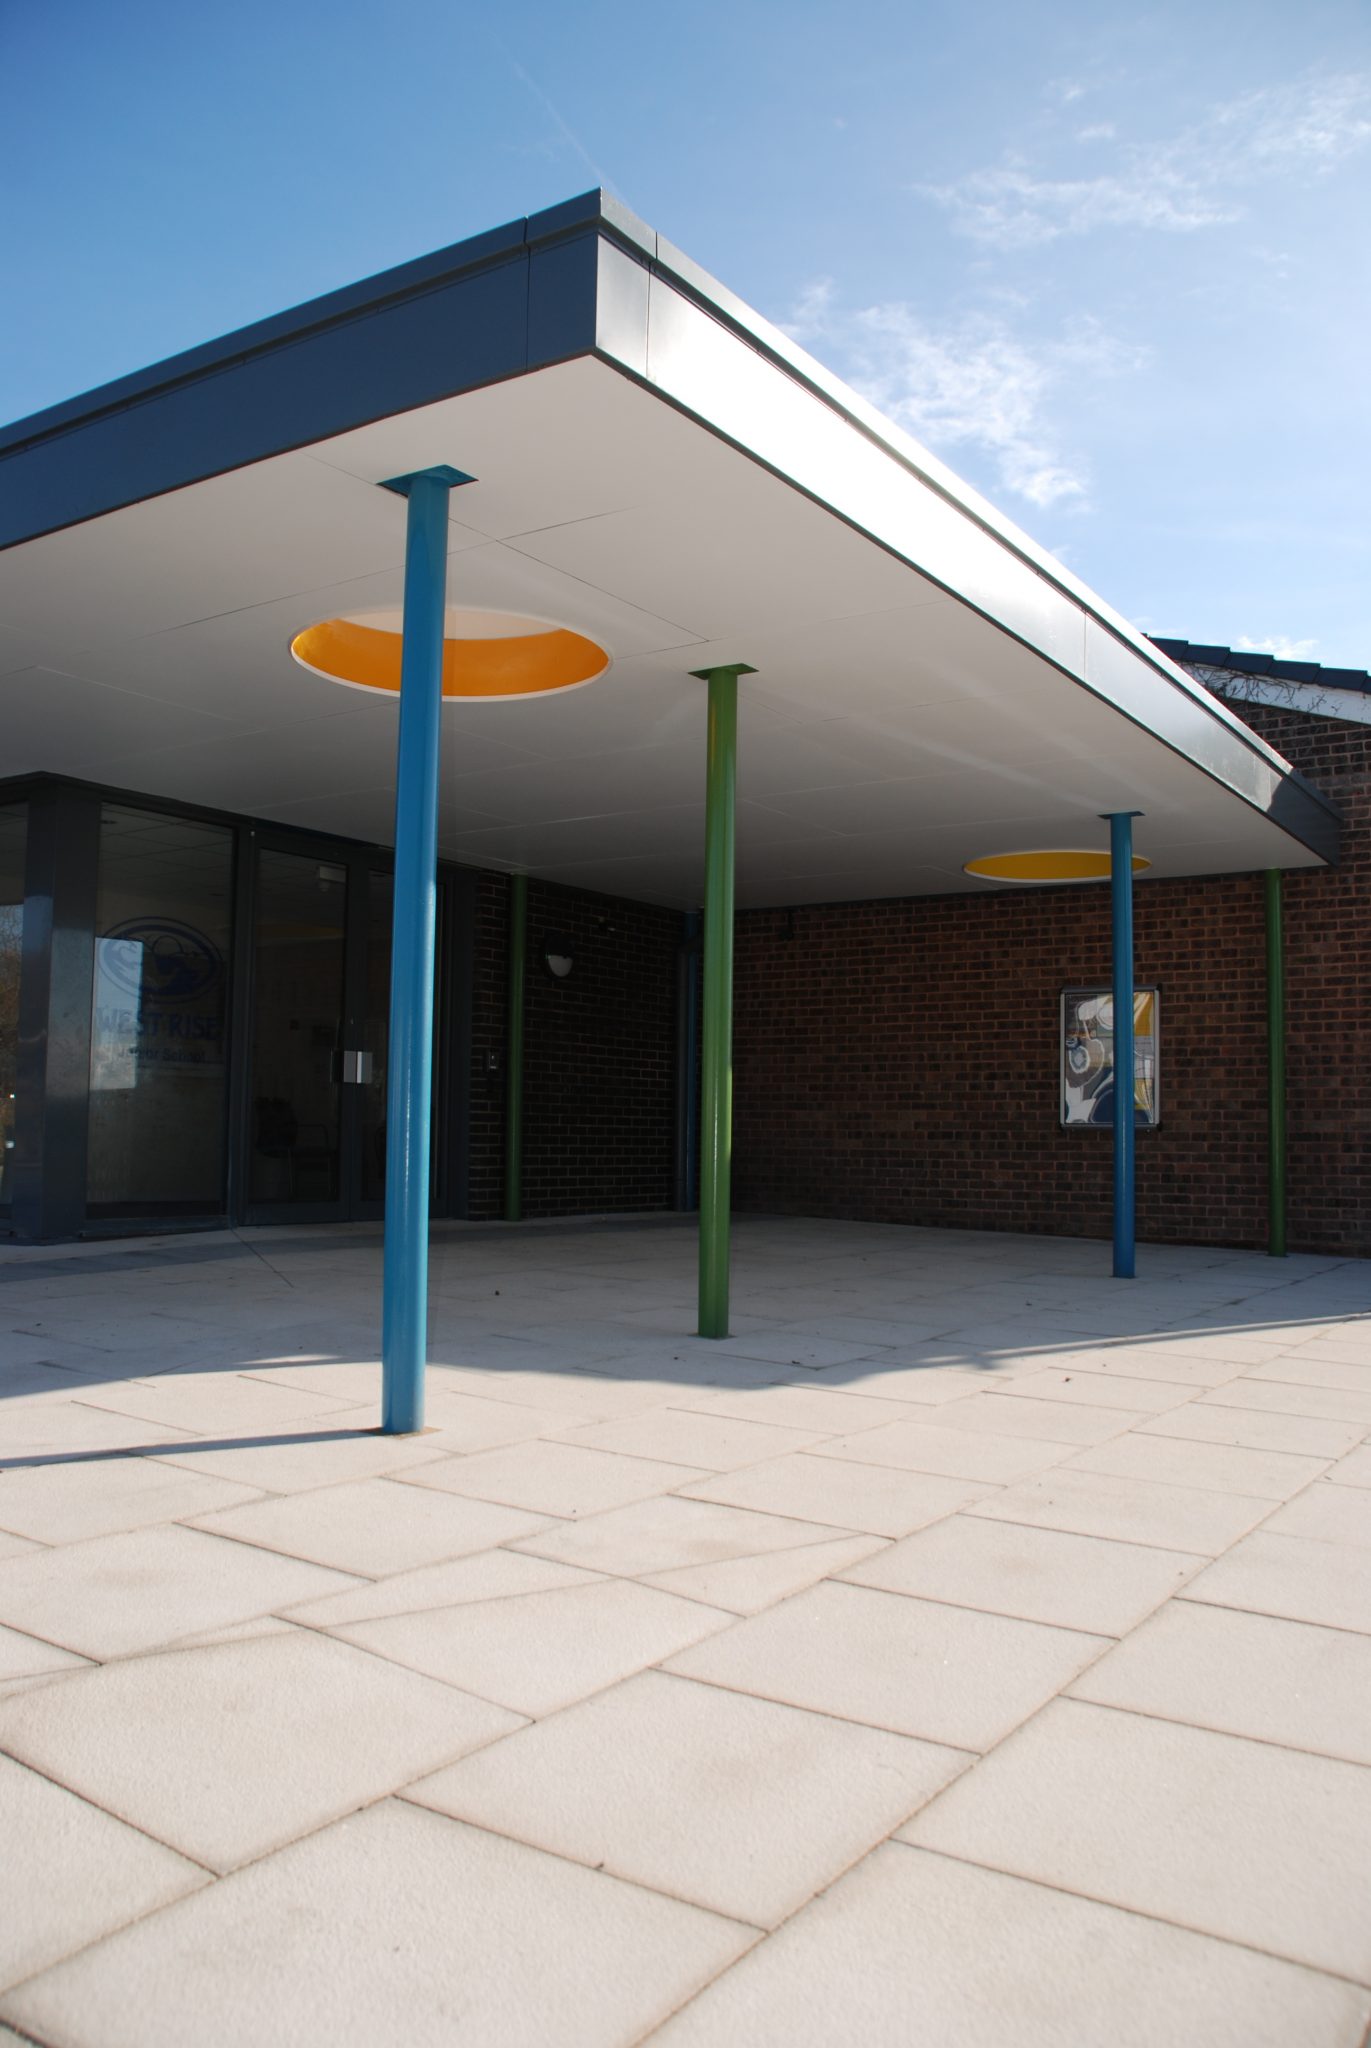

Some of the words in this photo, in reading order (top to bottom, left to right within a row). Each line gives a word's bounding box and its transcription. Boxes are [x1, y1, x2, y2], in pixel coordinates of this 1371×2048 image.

[96, 1008, 162, 1037] WEST
[169, 1012, 219, 1040] RISE
[162, 1048, 206, 1063] School
